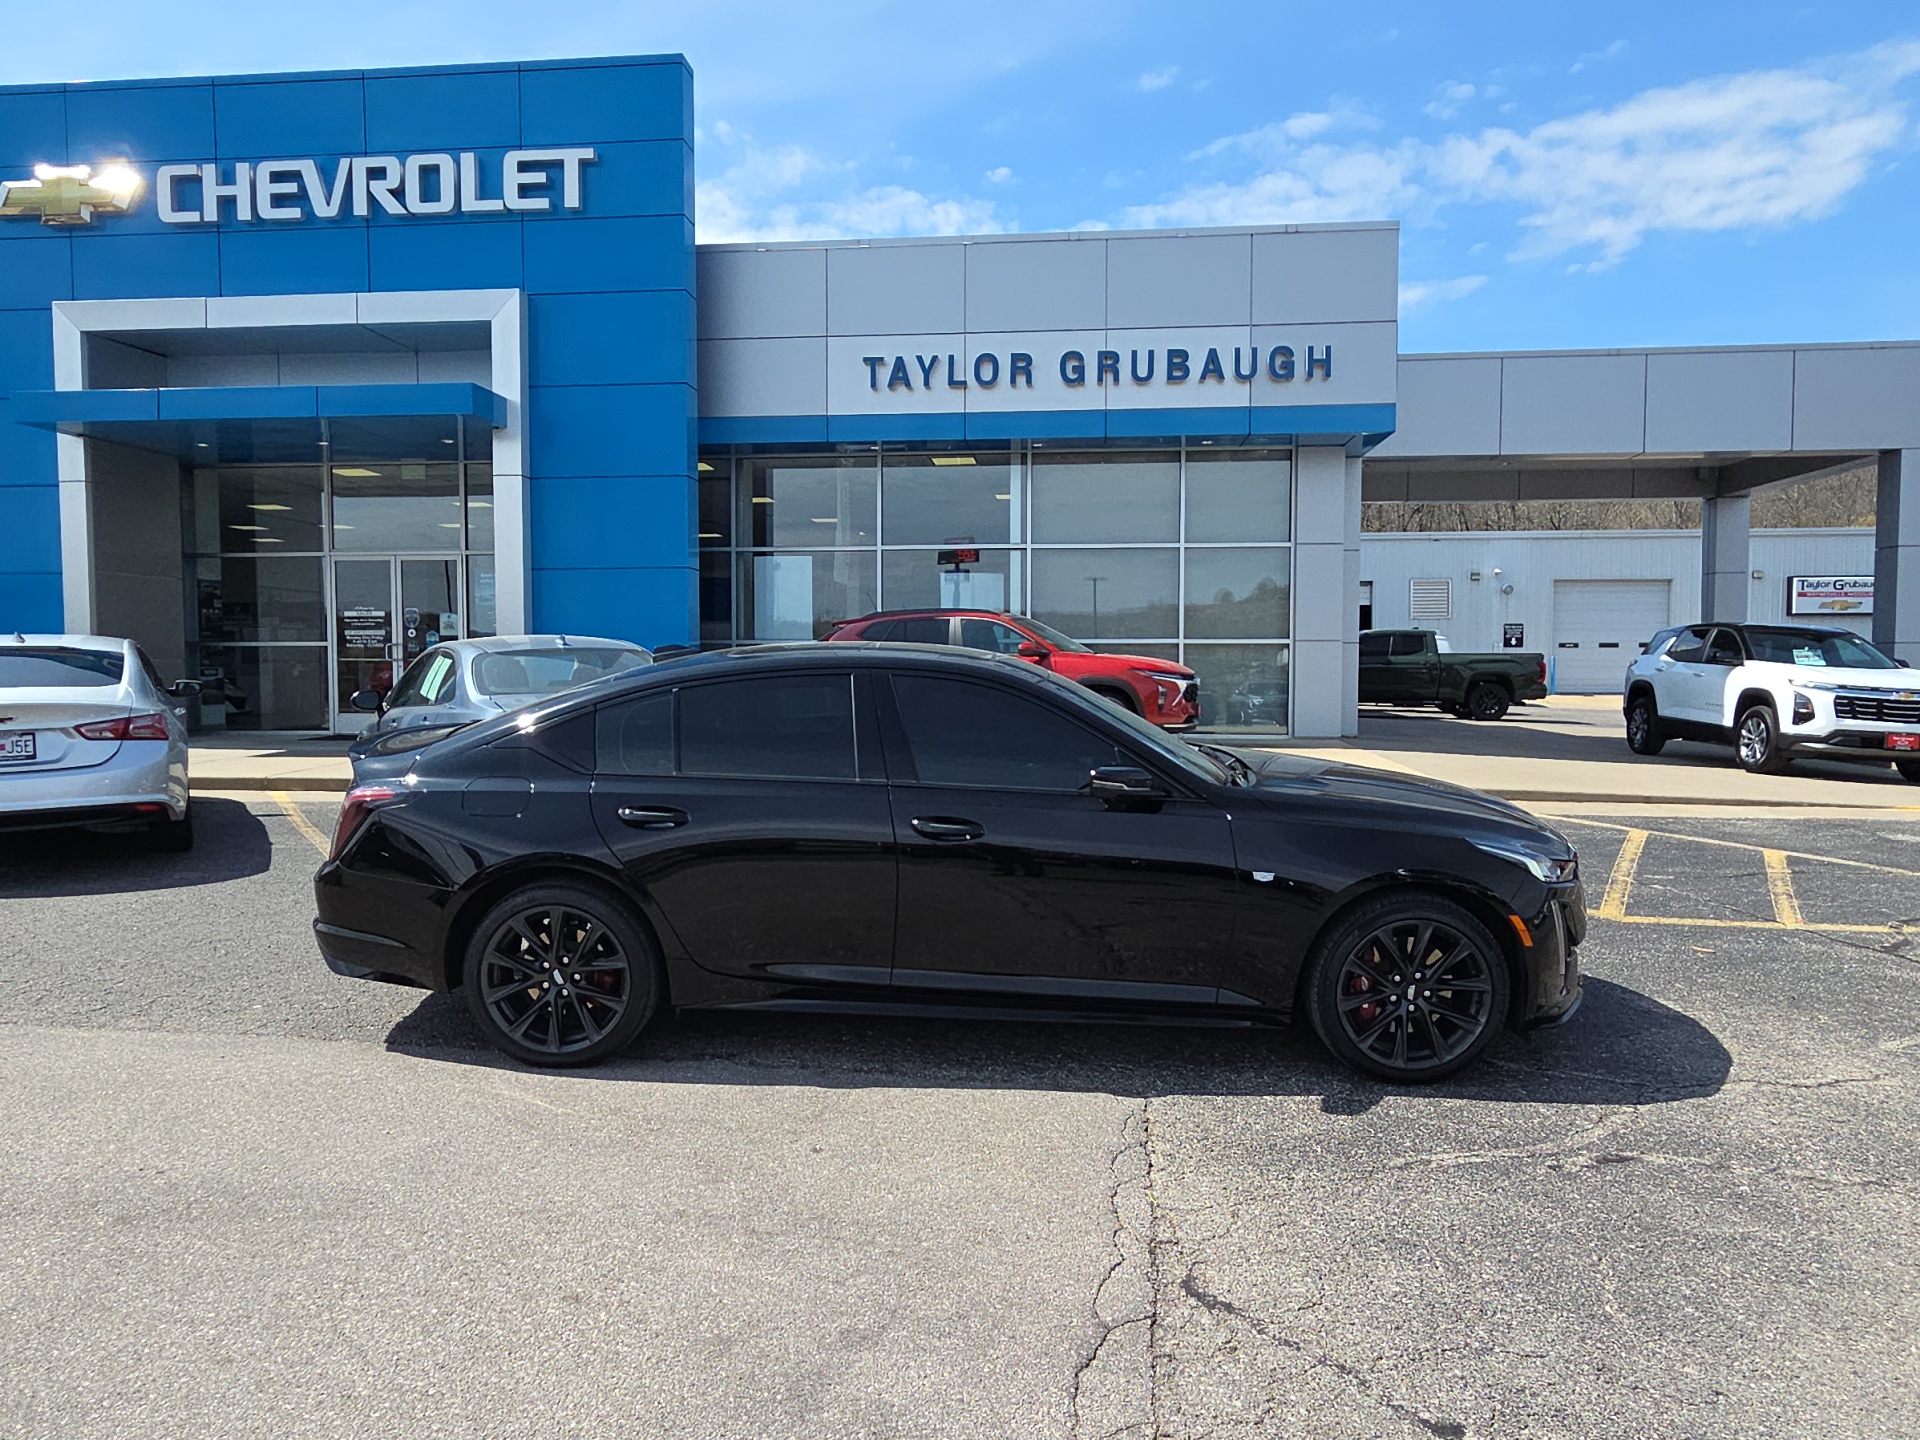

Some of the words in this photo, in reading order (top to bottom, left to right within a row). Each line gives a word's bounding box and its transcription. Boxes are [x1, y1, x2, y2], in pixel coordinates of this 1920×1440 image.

[157, 148, 595, 222] CHEVROLET
[863, 350, 1033, 391] TAYLOR
[1060, 343, 1334, 387] GRUBAUGH
[1798, 579, 1831, 590] Taylor
[6, 739, 32, 754] J5E
